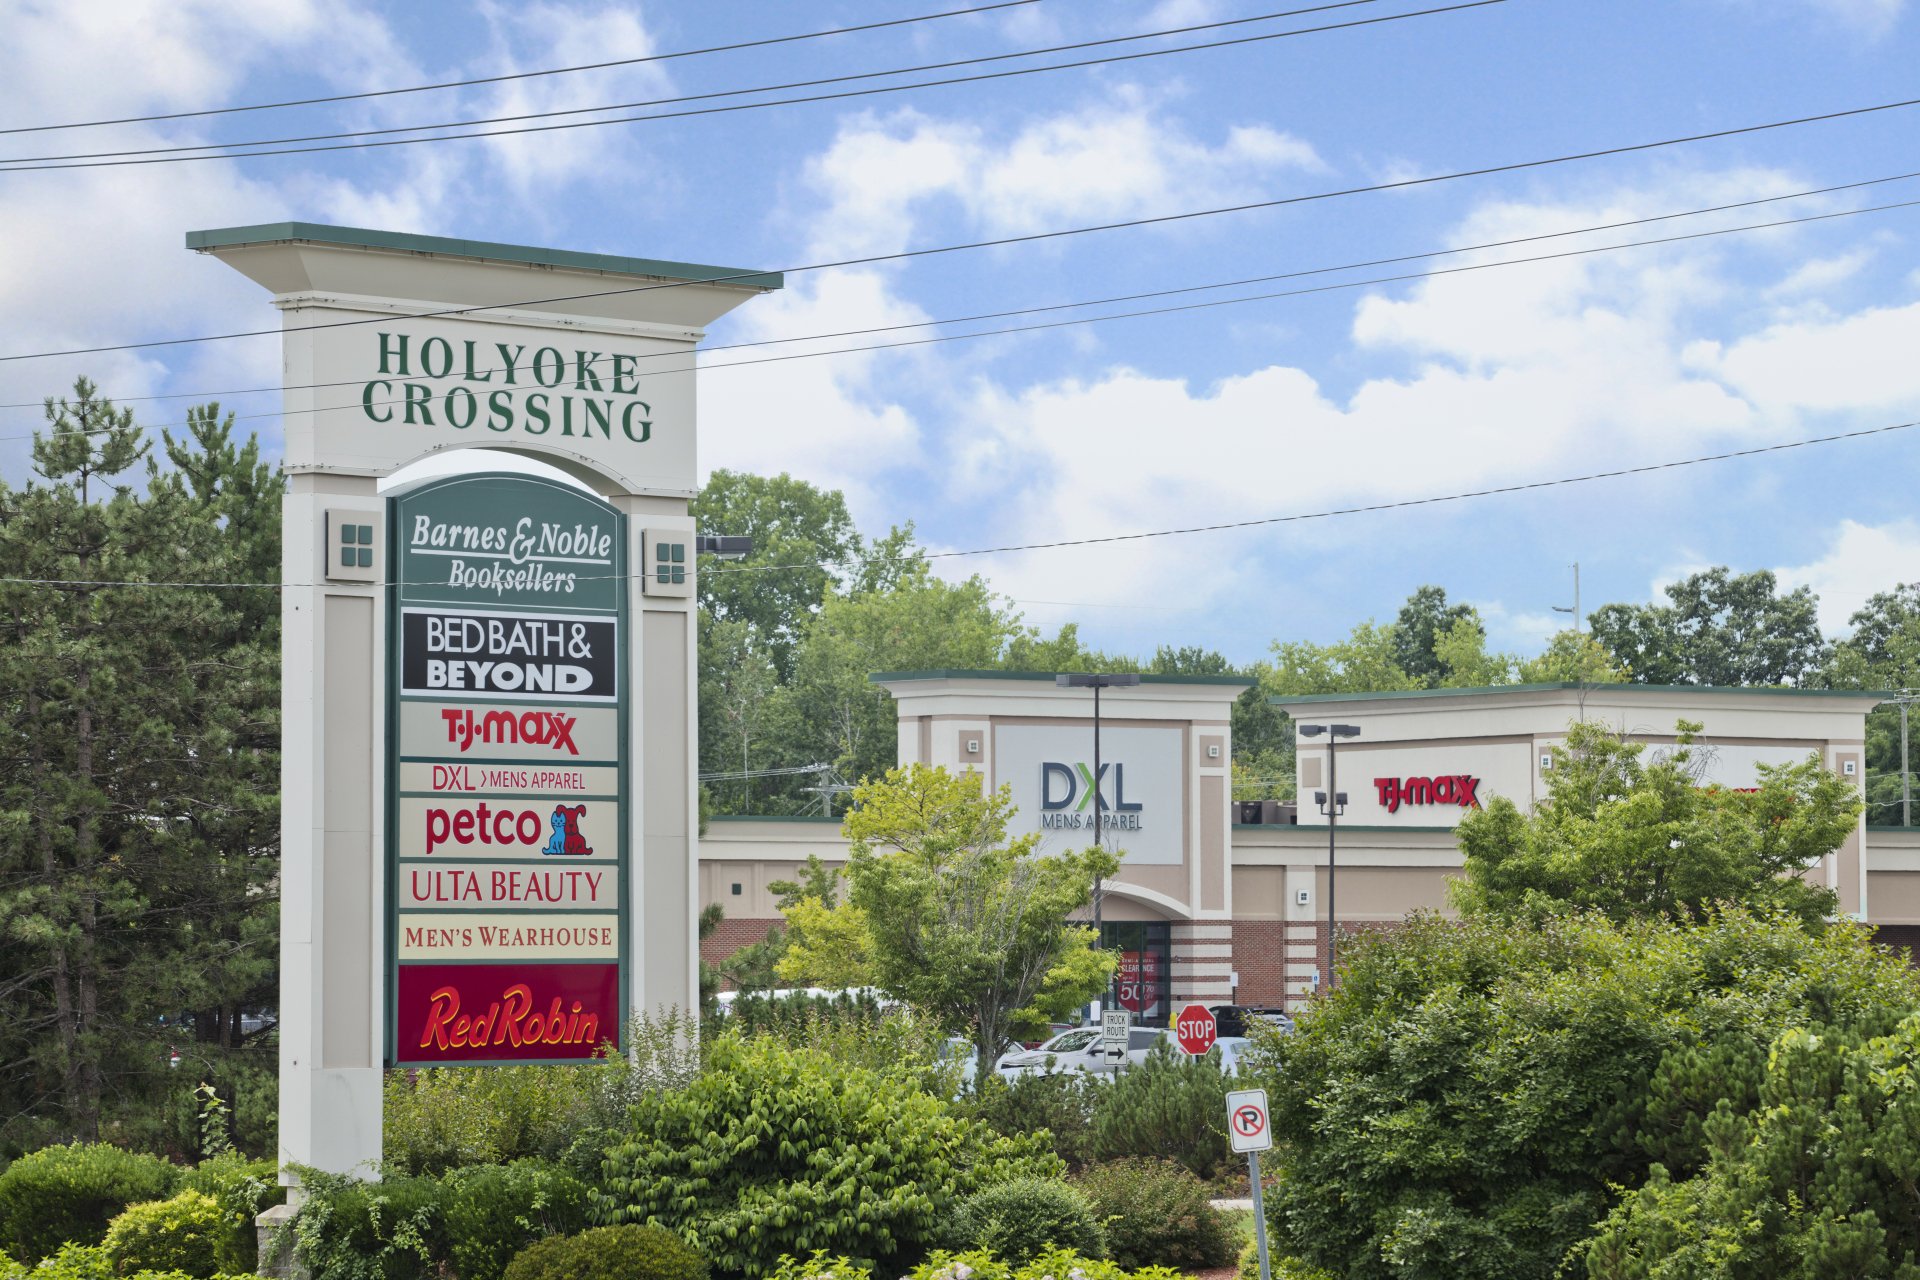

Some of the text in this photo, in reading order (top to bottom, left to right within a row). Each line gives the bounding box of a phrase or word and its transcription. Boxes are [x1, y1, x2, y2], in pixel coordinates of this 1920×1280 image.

[377, 332, 640, 395] HOLYOKE
[362, 379, 653, 443] CROSSING
[411, 514, 612, 565] Barnes & Noble
[448, 559, 576, 597] Booksellers
[426, 616, 593, 659] BED BATH &
[426, 659, 593, 692] BEYOND
[432, 765, 586, 791] DXL MENS APPAREL
[1042, 762, 1143, 811] DXL
[426, 802, 542, 854] petco
[1042, 814, 1081, 829] MENS
[412, 870, 602, 902] ULTA BEAUTY
[478, 926, 612, 947] WEARHOUSE
[1121, 964, 1154, 973] CLEARNCE
[420, 983, 599, 1051] Red Robin
[1106, 1015, 1126, 1025] TRUCK
[1106, 1026, 1126, 1037] ROUTE
[1179, 1020, 1214, 1040] STOP
